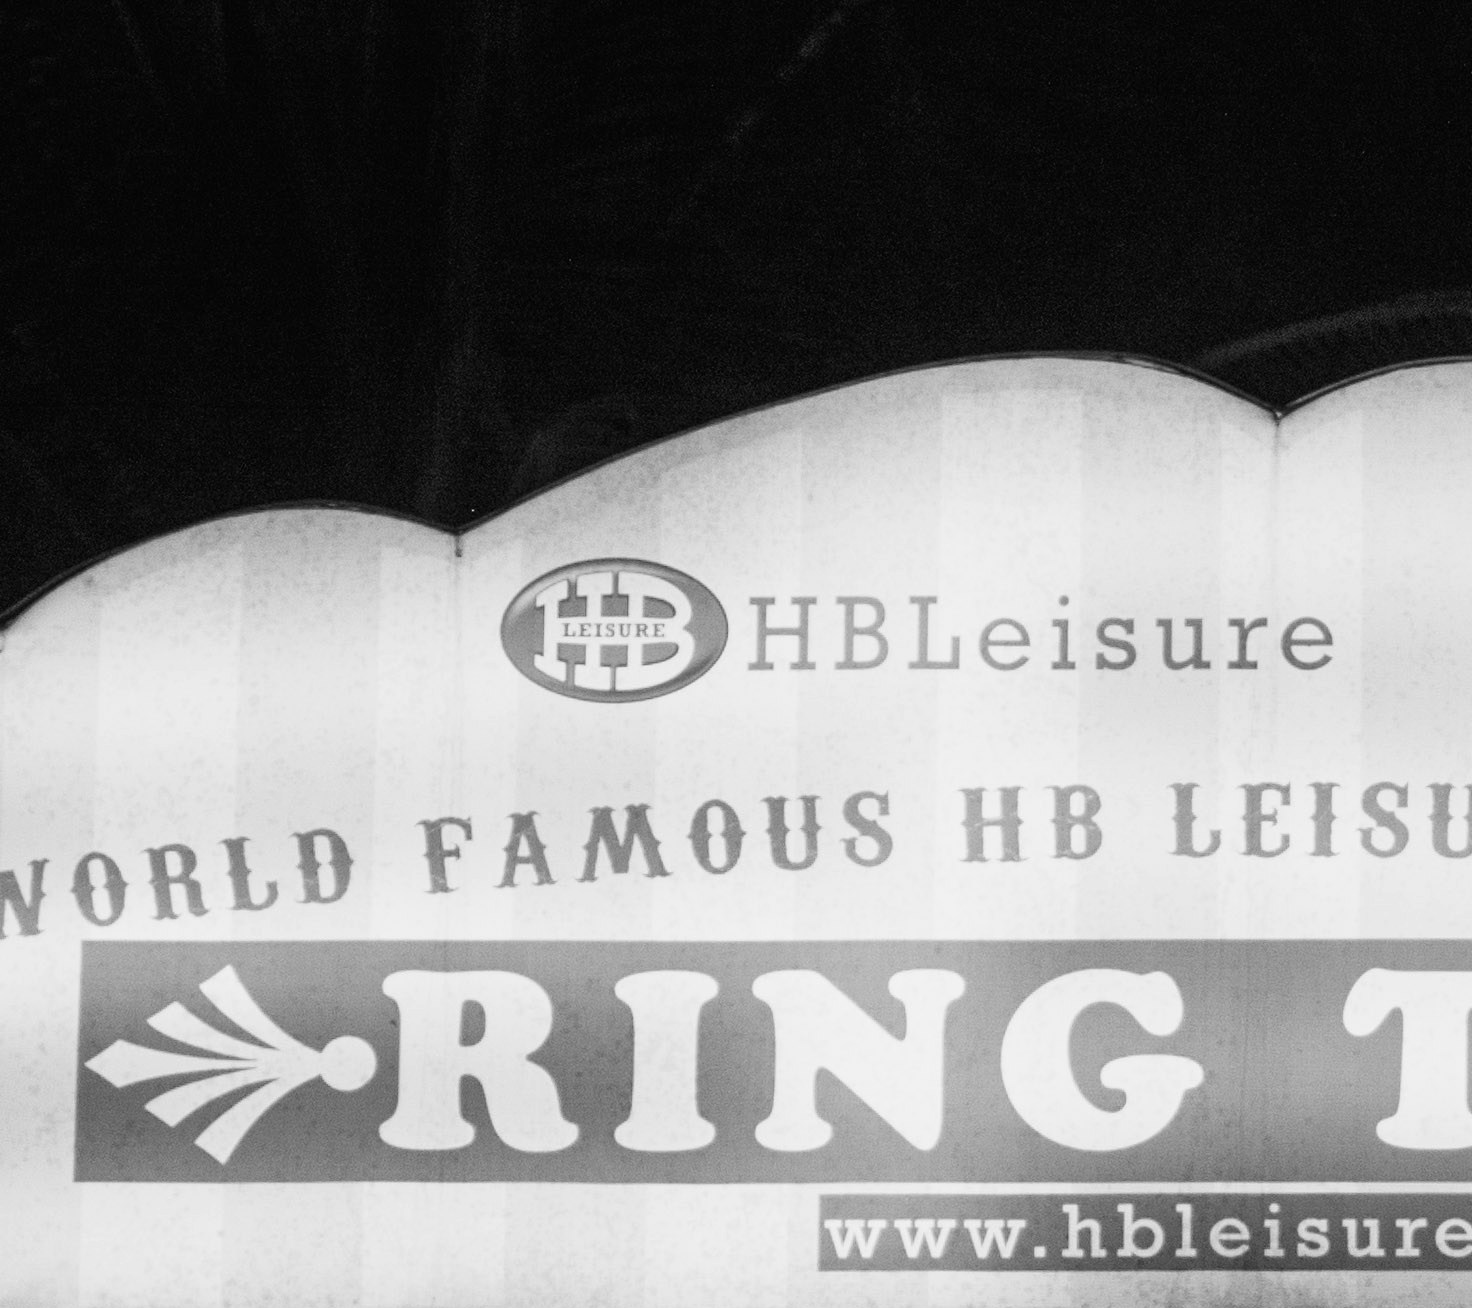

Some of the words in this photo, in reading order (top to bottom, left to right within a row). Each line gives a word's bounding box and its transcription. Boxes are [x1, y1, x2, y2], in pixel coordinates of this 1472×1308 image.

[561, 621, 667, 638] LEISURE
[747, 595, 1335, 671] HBLeisure
[415, 790, 894, 893] FAMOUS
[958, 784, 1104, 864] HB
[378, 967, 1205, 1153] RING
